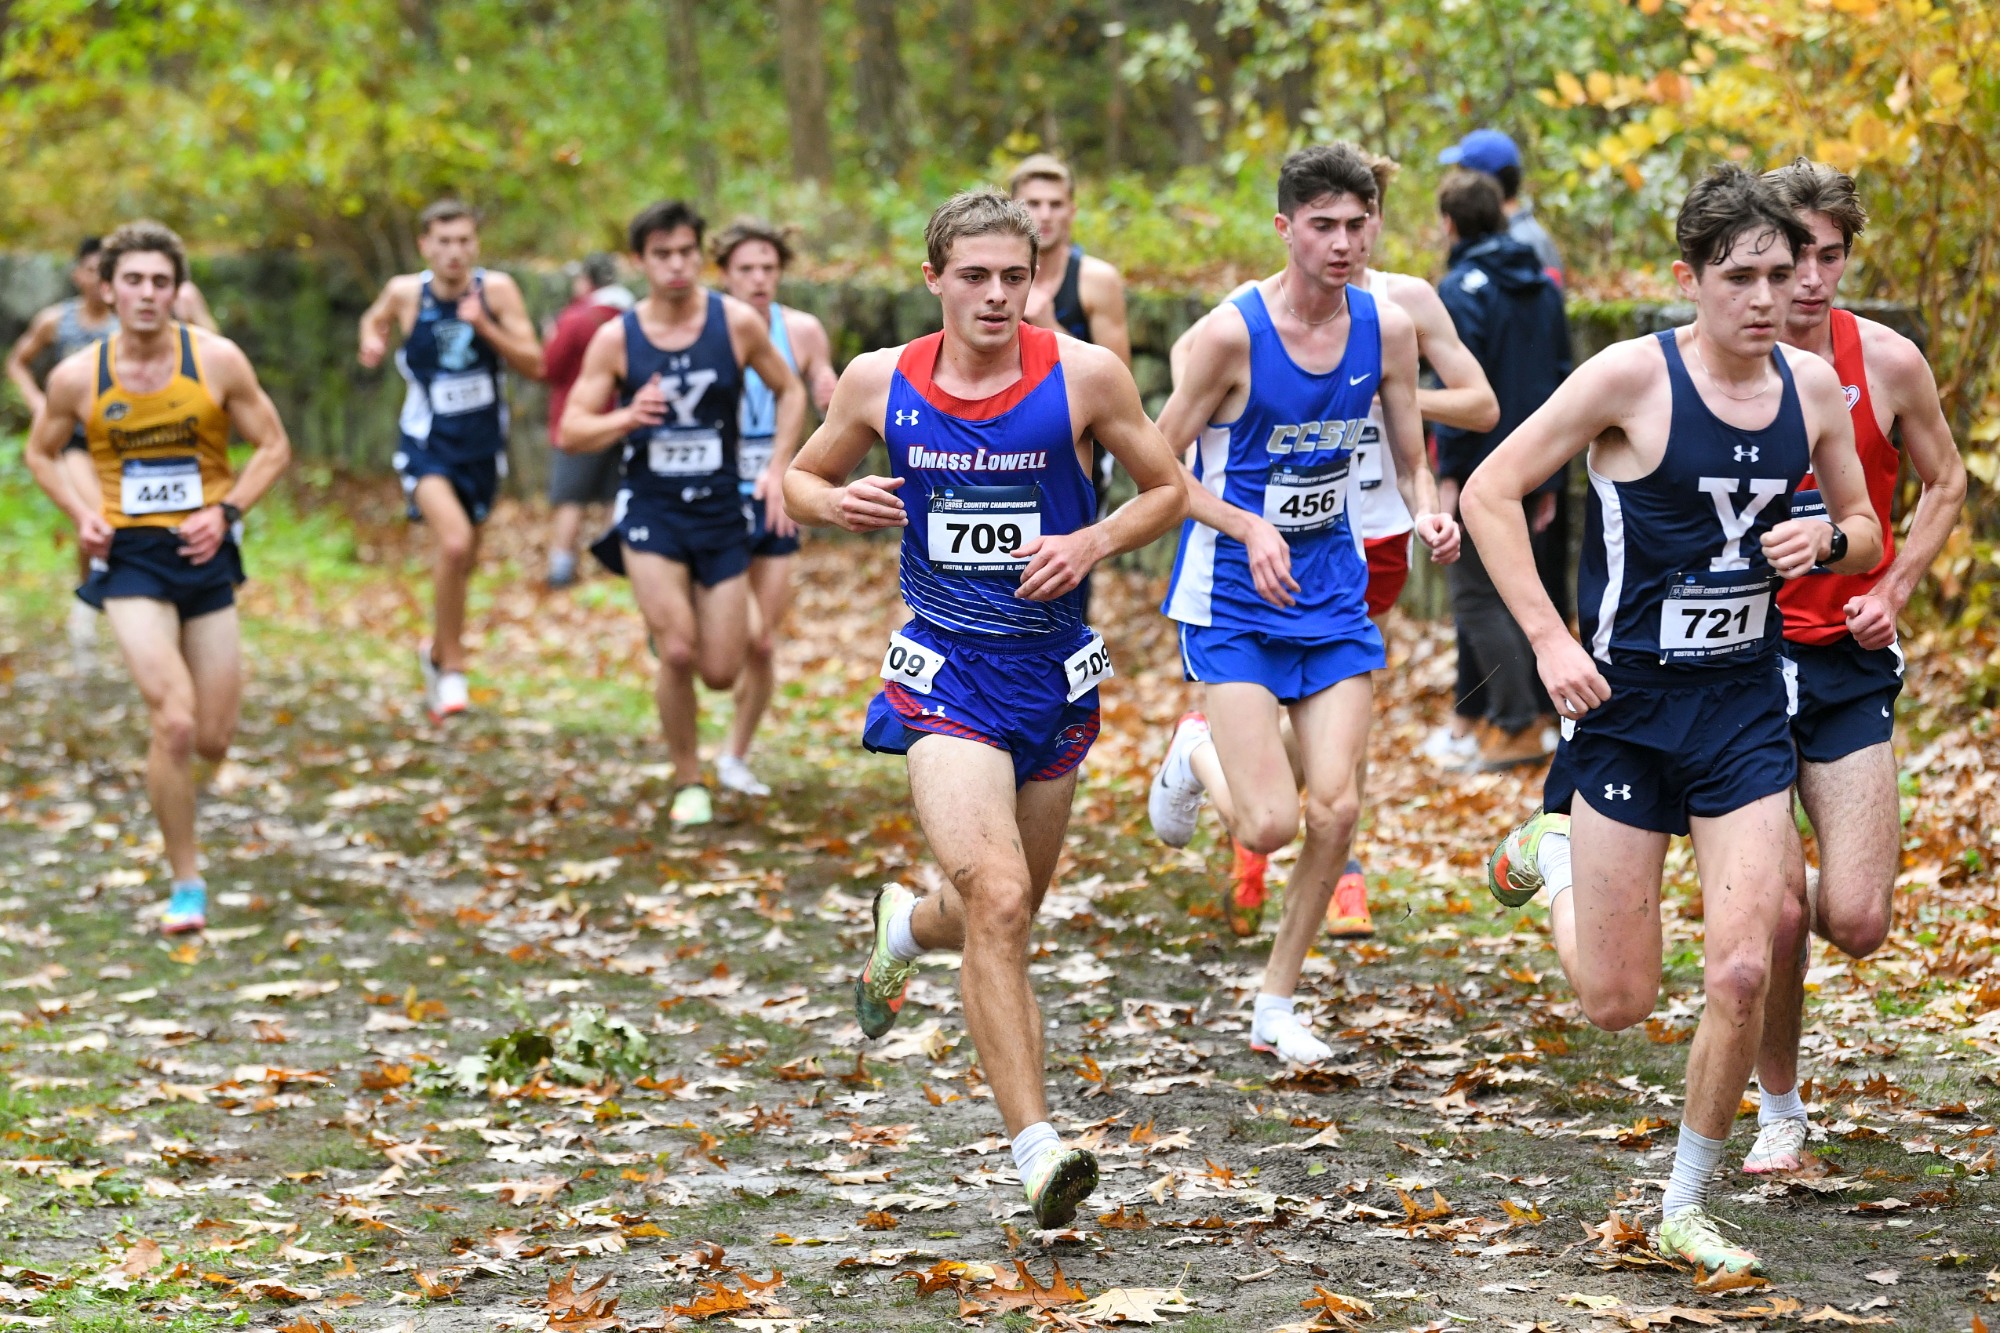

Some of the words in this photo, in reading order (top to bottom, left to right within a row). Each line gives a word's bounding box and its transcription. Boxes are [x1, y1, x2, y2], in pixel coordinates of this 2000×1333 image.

[1266, 418, 1368, 454] CCSU
[665, 446, 707, 463] 727
[138, 482, 187, 502] 445
[945, 501, 962, 509] CROSS
[963, 501, 989, 509] COUNTRY
[990, 501, 1037, 509] CHAMPIONSHIPS
[1280, 489, 1336, 518] 456
[946, 523, 1022, 554] 709
[1698, 477, 1788, 573] Y
[1729, 581, 1771, 593] CHAMPIONSHIPS
[1681, 605, 1750, 639] 721
[888, 641, 926, 677] 09
[1074, 644, 1110, 683] 709
